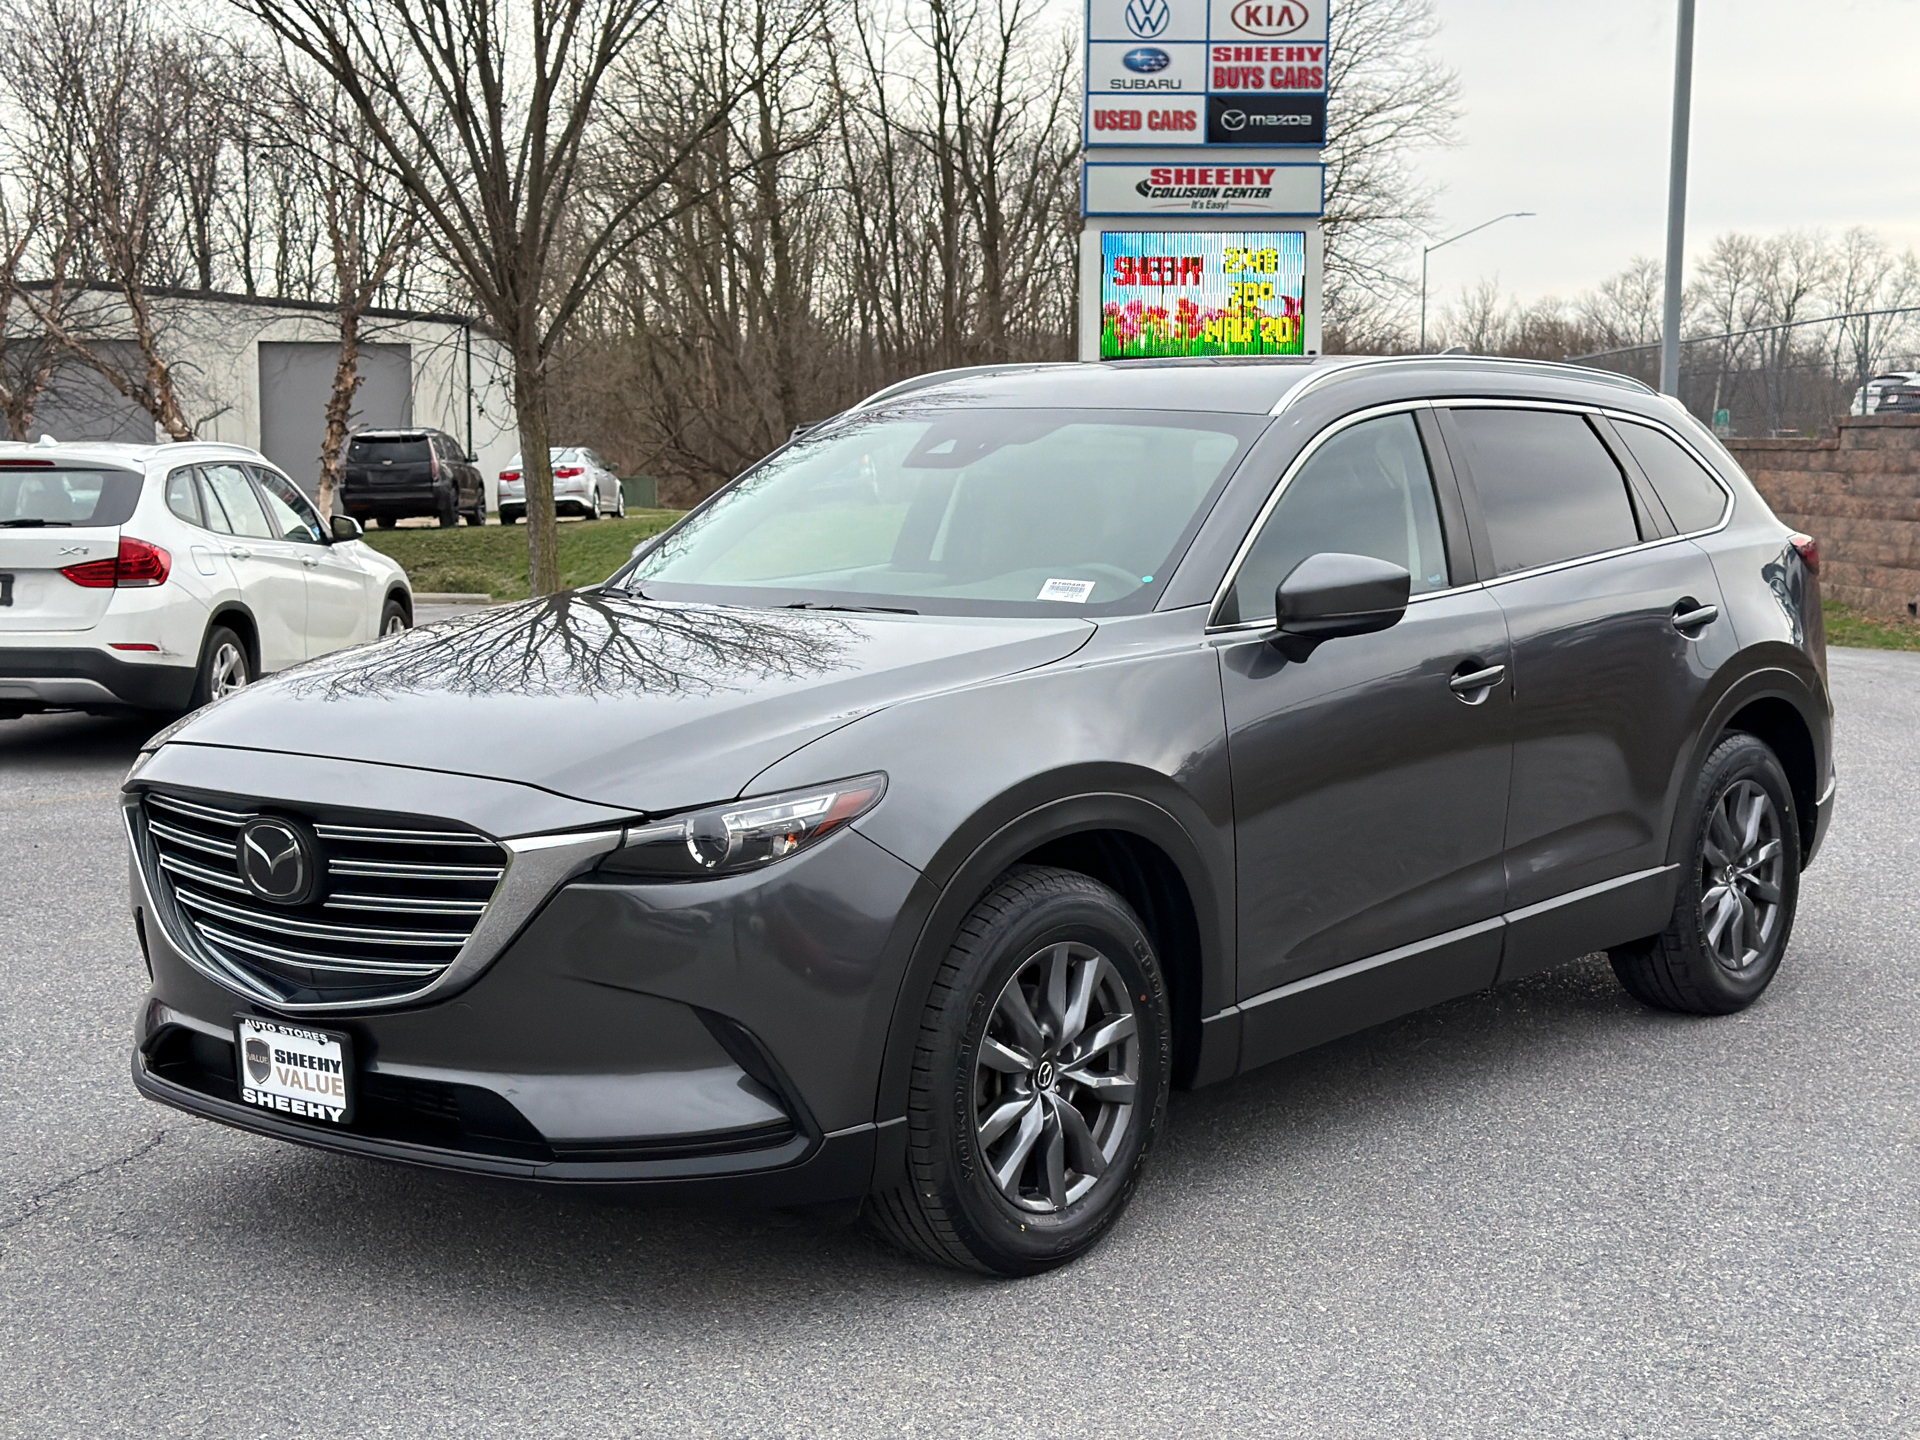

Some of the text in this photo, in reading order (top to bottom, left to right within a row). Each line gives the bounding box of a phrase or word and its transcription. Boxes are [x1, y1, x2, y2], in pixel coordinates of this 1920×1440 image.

[1245, 5, 1296, 27] KIA
[1213, 47, 1323, 62] SHEEHY
[1110, 79, 1181, 89] SUBARU
[1213, 66, 1323, 89] BUYS CARS
[1094, 110, 1197, 131] USED CARS
[1150, 169, 1276, 185] SHEEHY
[1151, 187, 1272, 198] COLLISION CENTER
[1191, 200, 1229, 210] It's Easy!
[1260, 316, 1291, 343] 20
[58, 546, 90, 556] X1
[244, 1019, 329, 1043] AUTO STORES
[274, 1049, 341, 1074] SHEEHY
[276, 1066, 344, 1097] VALUE
[242, 1088, 344, 1122] SHEEHY
